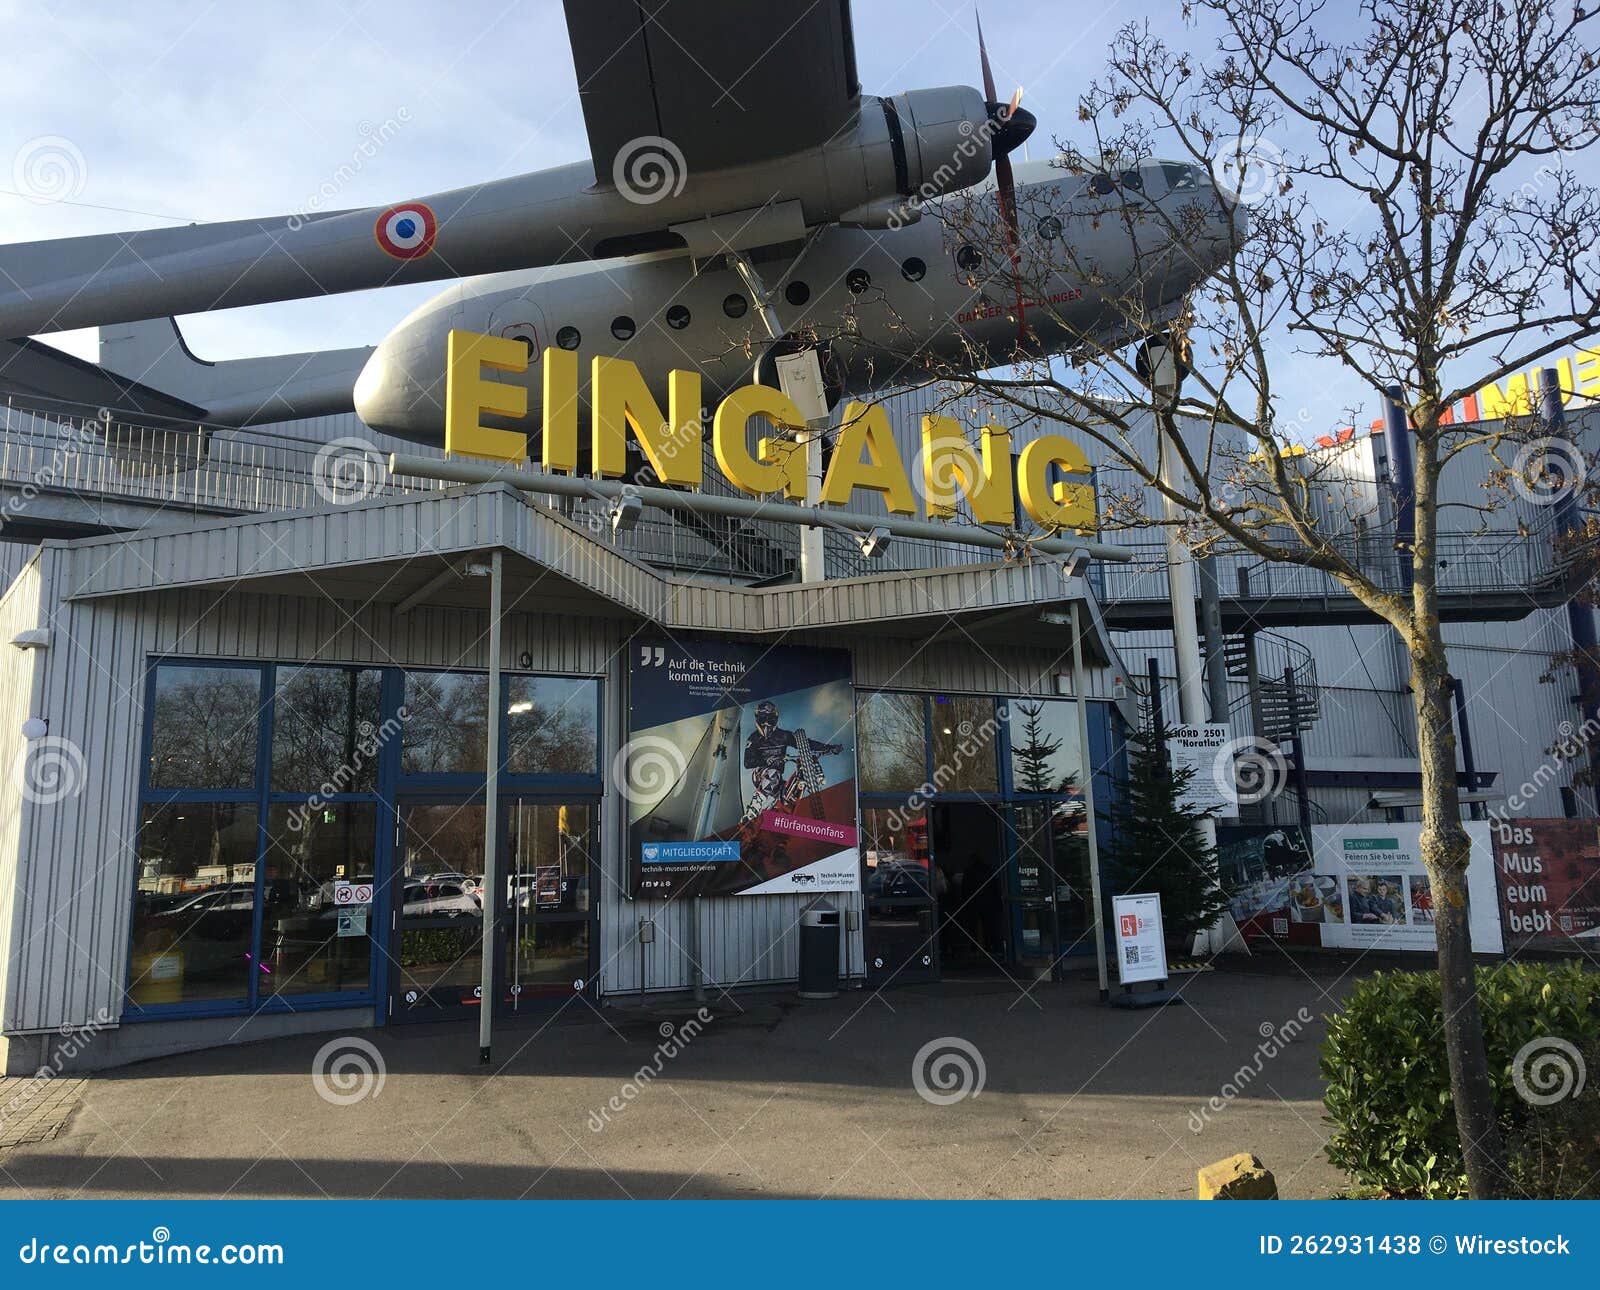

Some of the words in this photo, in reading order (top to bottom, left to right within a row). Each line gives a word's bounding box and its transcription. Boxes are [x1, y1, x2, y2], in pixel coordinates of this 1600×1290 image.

[444, 328, 1097, 537] EINGANG
[668, 659, 686, 670] Auf
[689, 660, 705, 671] die
[707, 660, 746, 673] Technik
[668, 671, 704, 683] kommt
[706, 674, 718, 683] es
[720, 674, 736, 684] an!
[1204, 728, 1225, 738] 2501
[1177, 738, 1225, 748] "Noratlas"
[774, 817, 845, 839] #fürfansvonfans
[1500, 823, 1534, 845] Das
[662, 847, 733, 857] MITGLIEDSCHAFT
[1344, 853, 1368, 861] Feiern
[1369, 853, 1381, 861] Sie
[1503, 852, 1543, 874] Mus
[1506, 885, 1547, 903] eum
[1509, 909, 1552, 933] bebt
